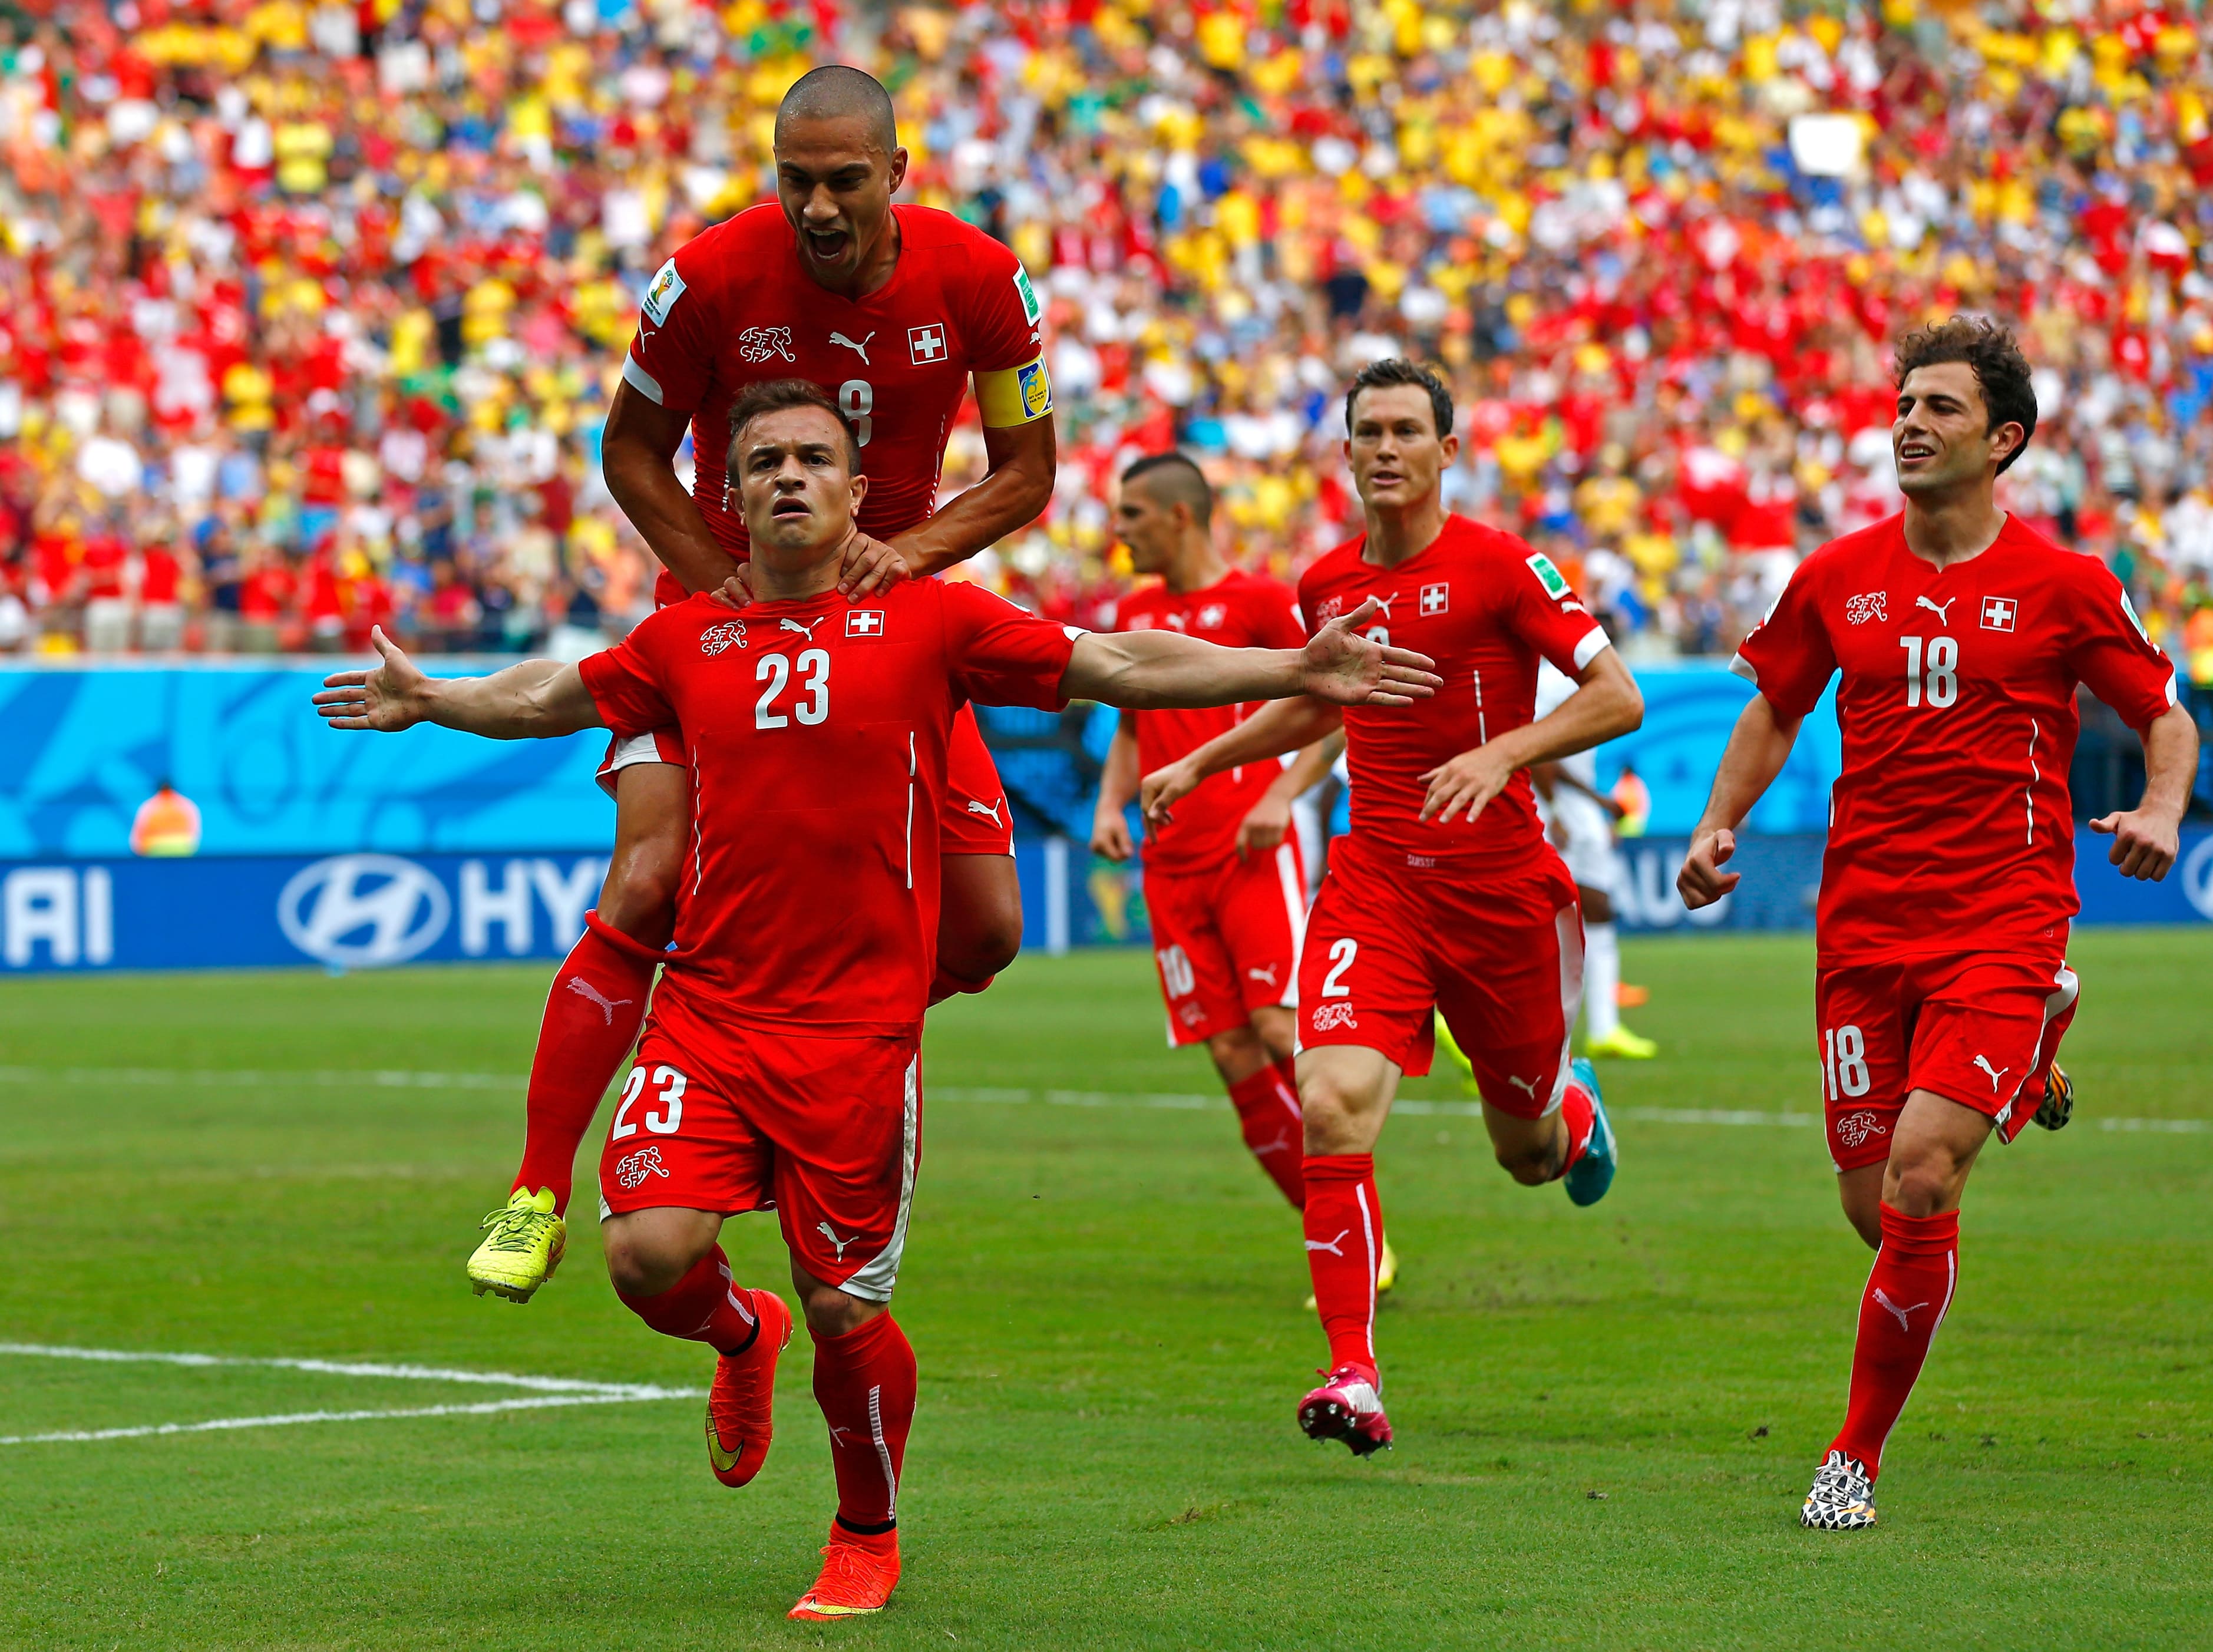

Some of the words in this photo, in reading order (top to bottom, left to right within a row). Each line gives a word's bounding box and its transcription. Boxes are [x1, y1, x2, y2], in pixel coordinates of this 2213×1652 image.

[756, 648, 830, 729] 23
[1900, 636, 1958, 708] 18
[1158, 944, 1195, 1000] 10
[1322, 938, 1357, 997] 2
[1825, 1025, 1871, 1101] 18
[613, 1065, 688, 1141] 23
